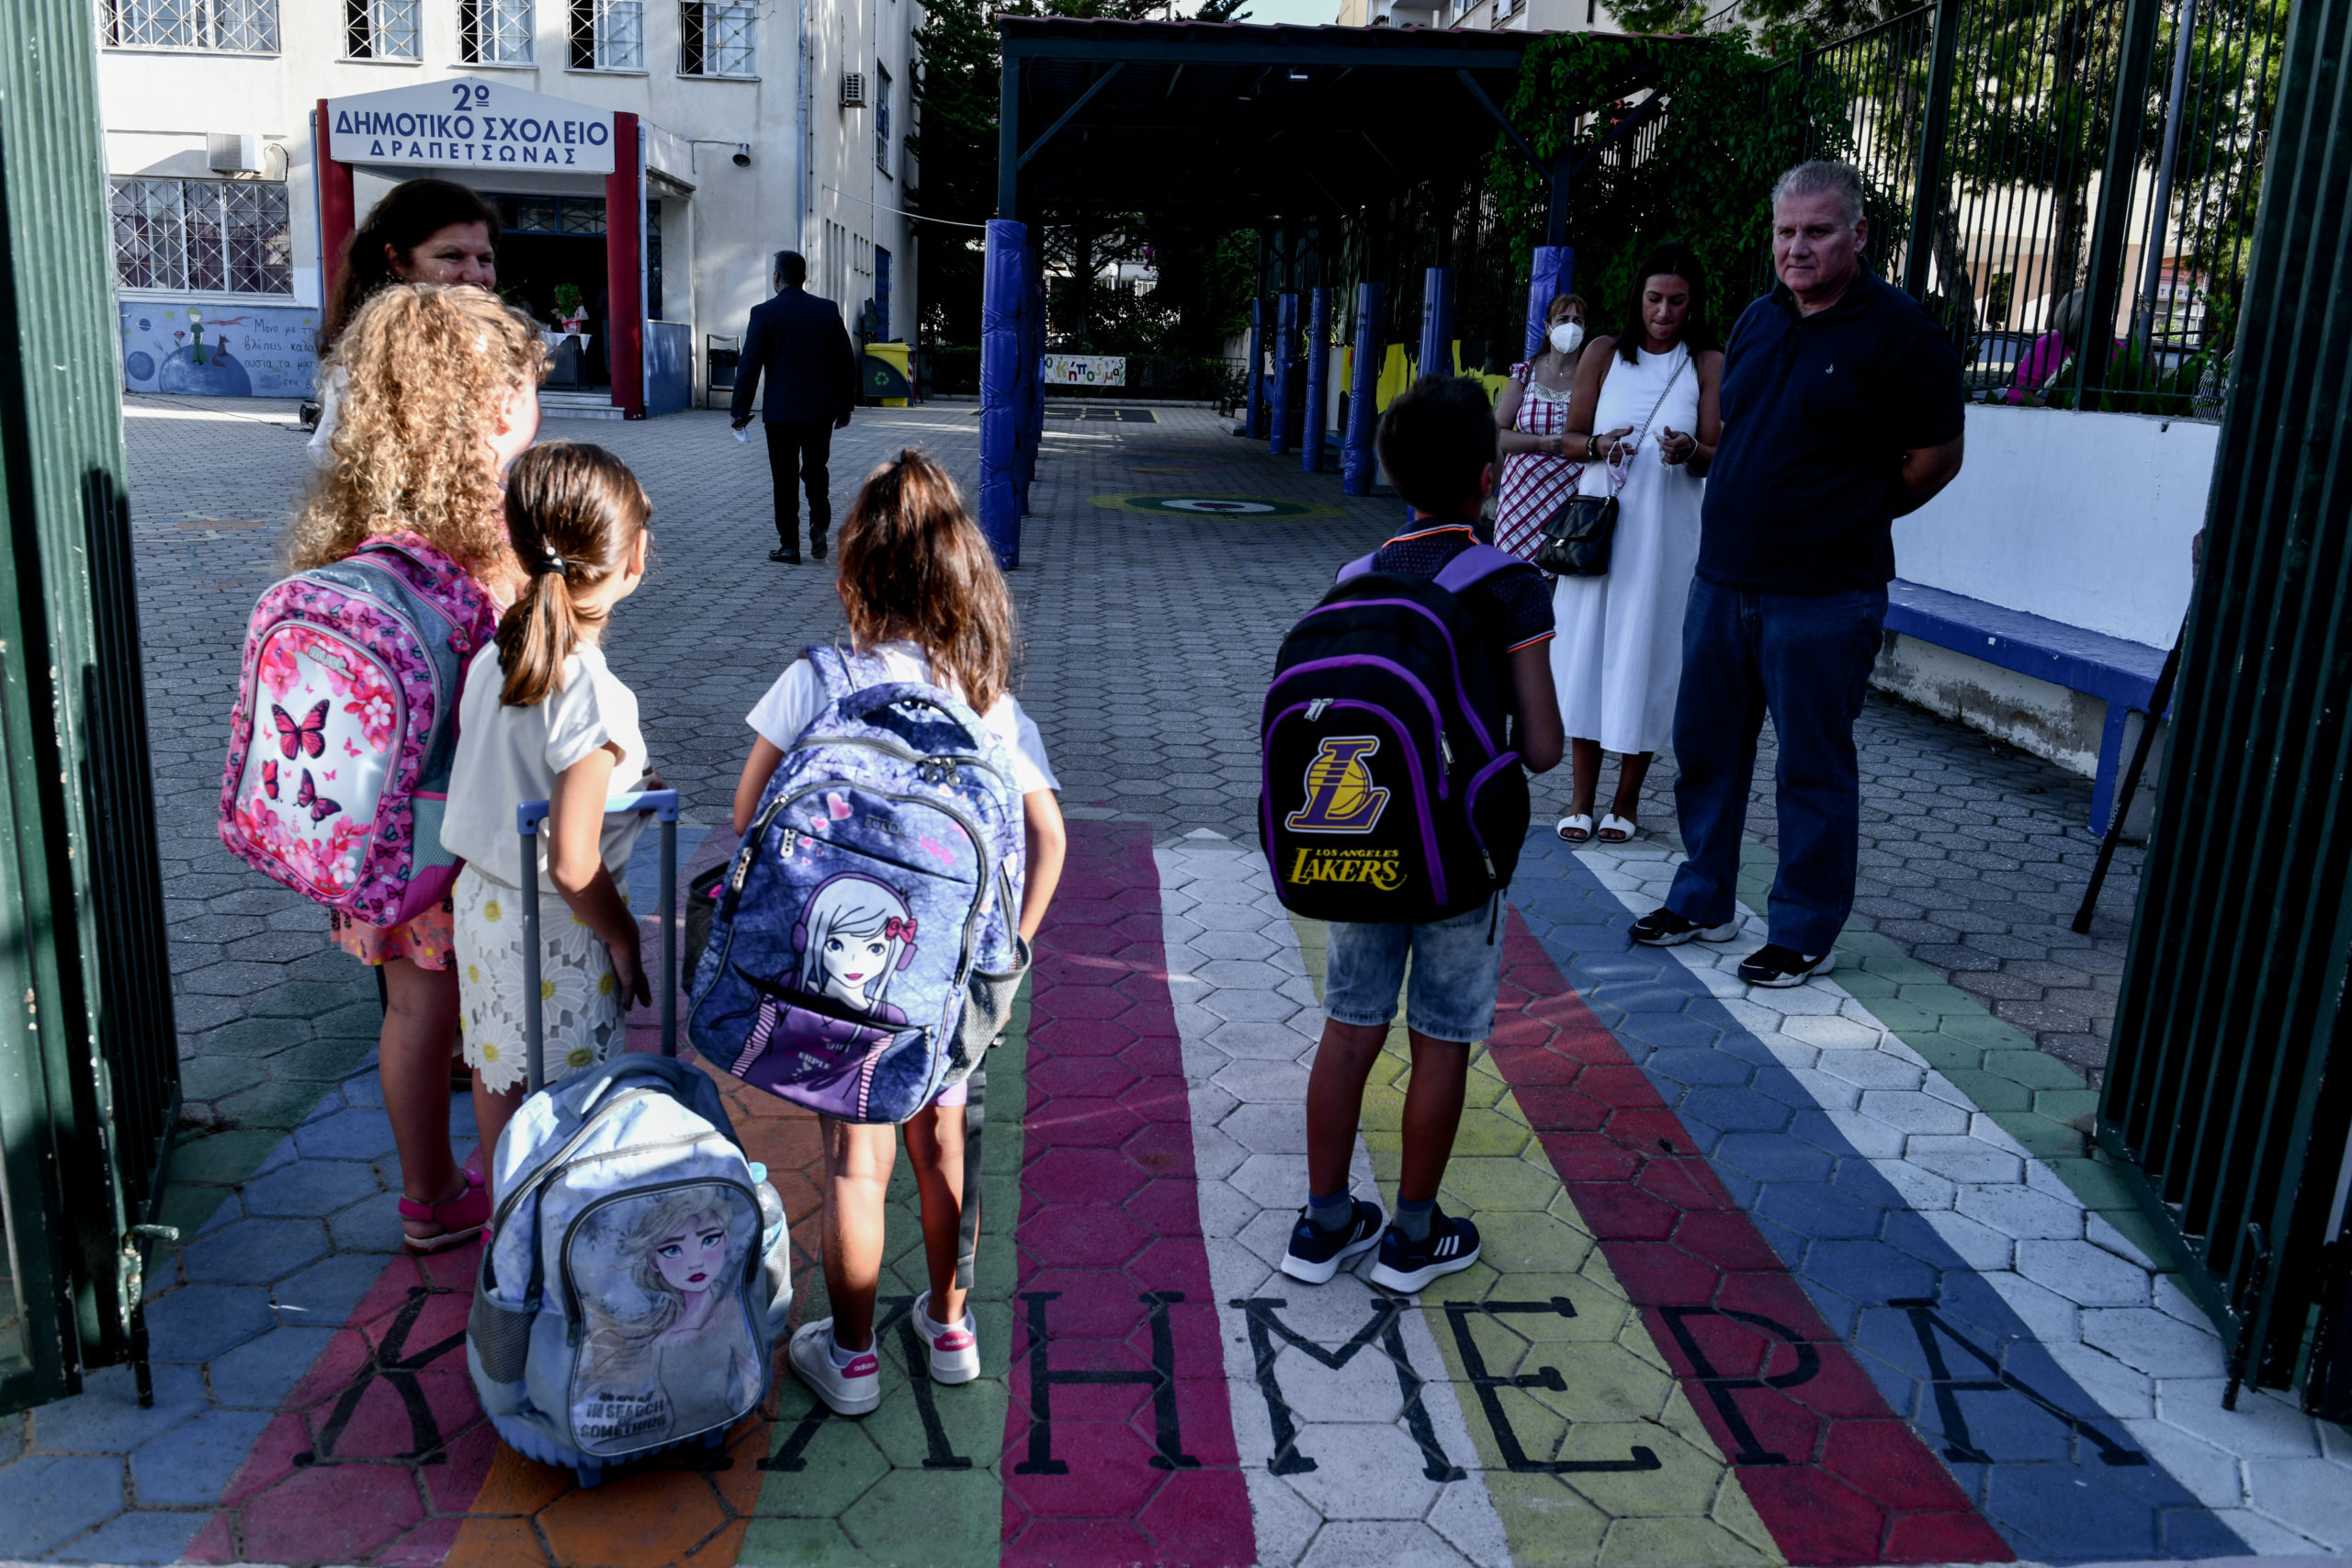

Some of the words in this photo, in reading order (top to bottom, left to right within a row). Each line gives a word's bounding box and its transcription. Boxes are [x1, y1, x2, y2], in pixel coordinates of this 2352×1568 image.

[335, 110, 474, 140] ΔΗΜΟΤΙΚΟ
[482, 118, 608, 146] ΣΧΟΛΕΙΟ
[370, 140, 575, 165] ΔΡΑΠΕΤΣΩΝΑΣ
[1316, 849, 1338, 857] LOS
[1340, 849, 1399, 858] ANGELES
[1287, 847, 1408, 891] LAKERS
[944, 1337, 968, 1347] adidas
[293, 1287, 2150, 1481] ΚΛΗΜΕΡΑ
[586, 1404, 604, 1418] IN
[606, 1399, 663, 1418] SEARCH
[581, 1415, 666, 1438] SOMETHING
